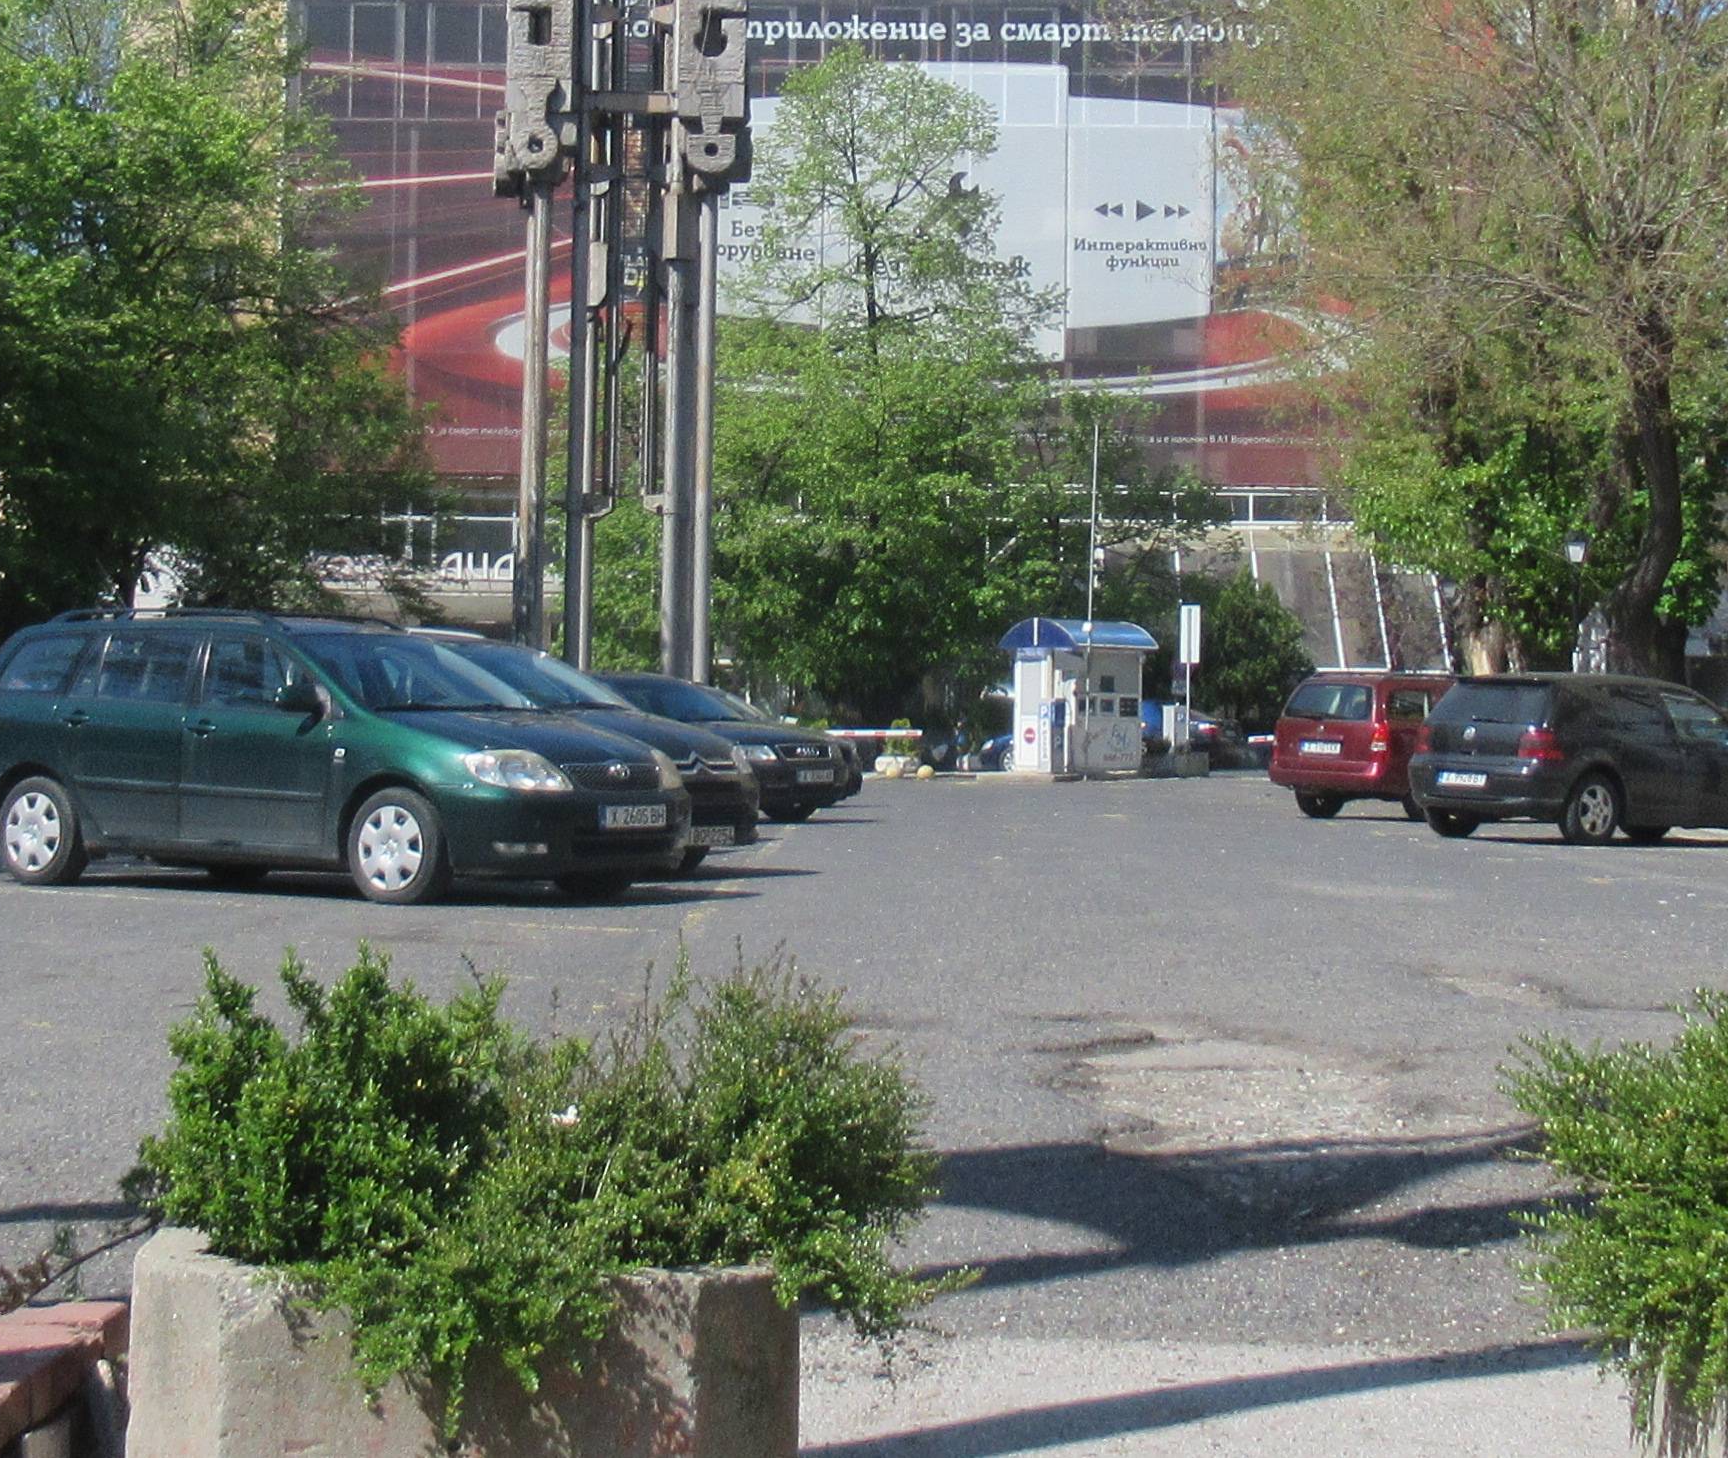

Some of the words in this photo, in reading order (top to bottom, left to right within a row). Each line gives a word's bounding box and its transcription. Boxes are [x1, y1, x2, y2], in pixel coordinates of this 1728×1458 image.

[955, 21, 990, 47] за
[1000, 20, 1109, 48] смарт
[1106, 255, 1180, 271] функции
